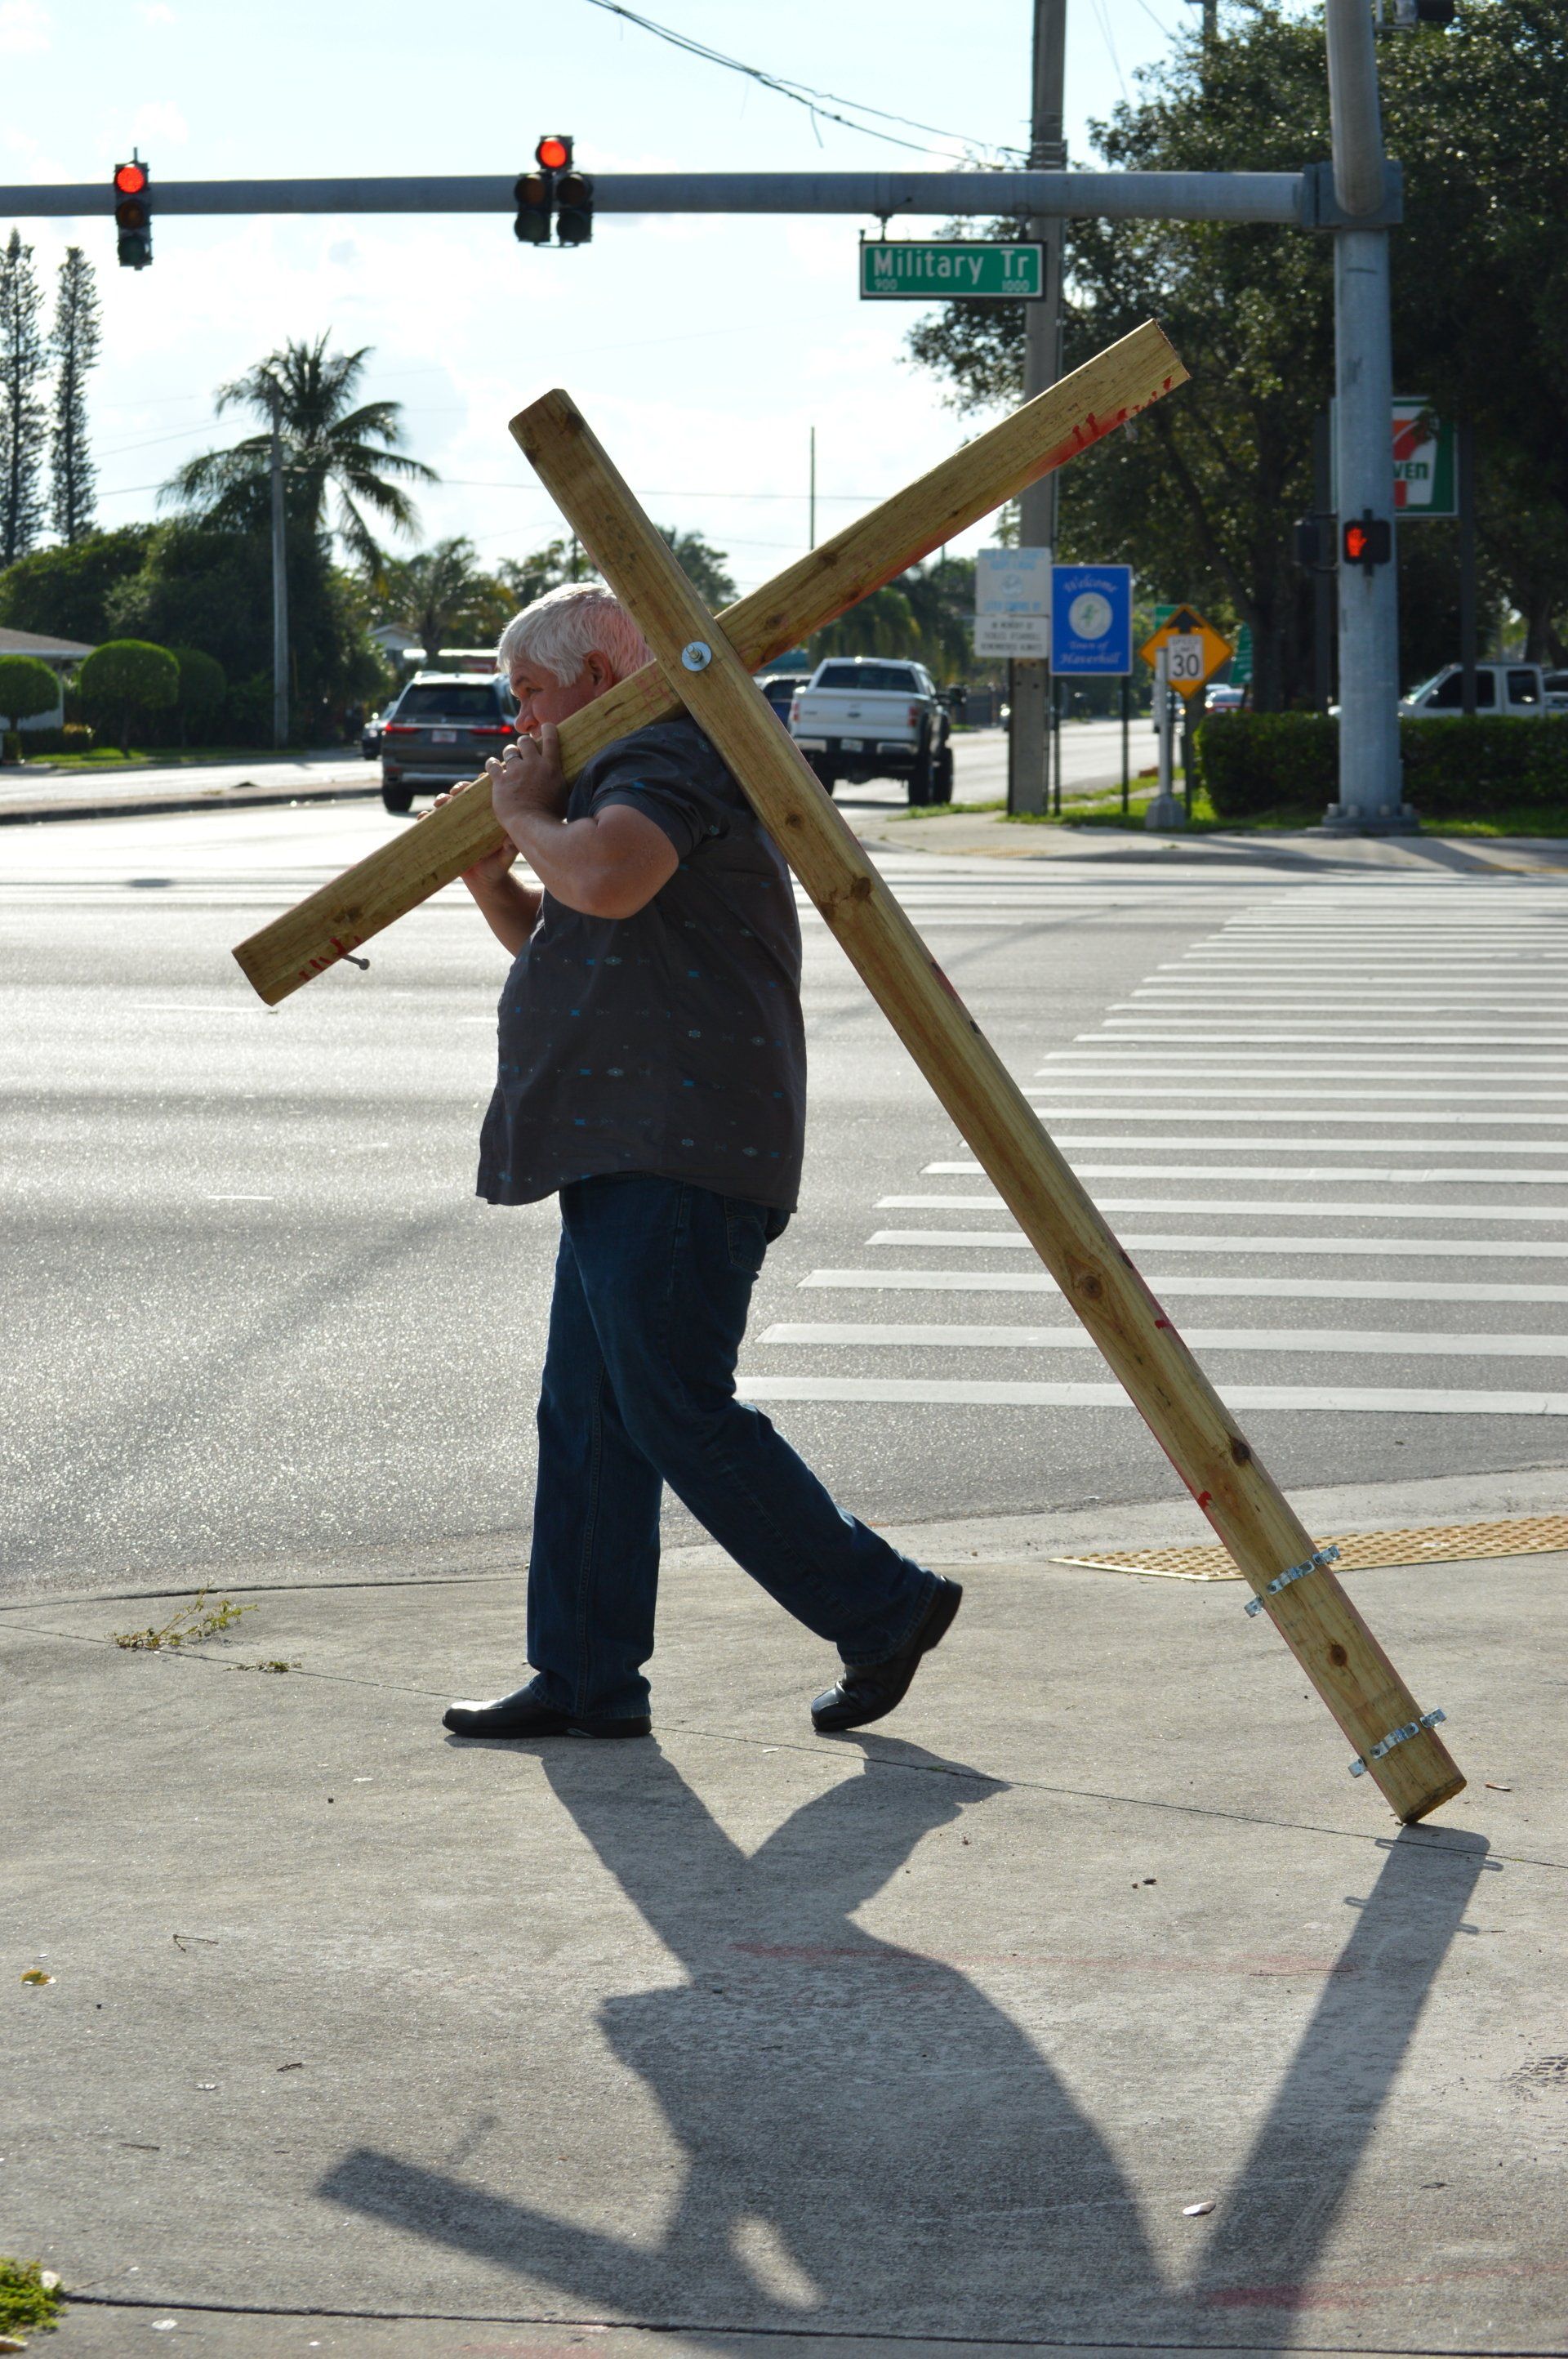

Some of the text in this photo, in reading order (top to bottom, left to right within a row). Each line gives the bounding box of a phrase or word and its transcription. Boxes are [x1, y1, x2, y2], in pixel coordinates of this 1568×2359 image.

[873, 249, 1030, 285] Military Tr
[874, 279, 898, 291] 900
[1063, 574, 1118, 592] Welcome
[1172, 654, 1199, 677] 30
